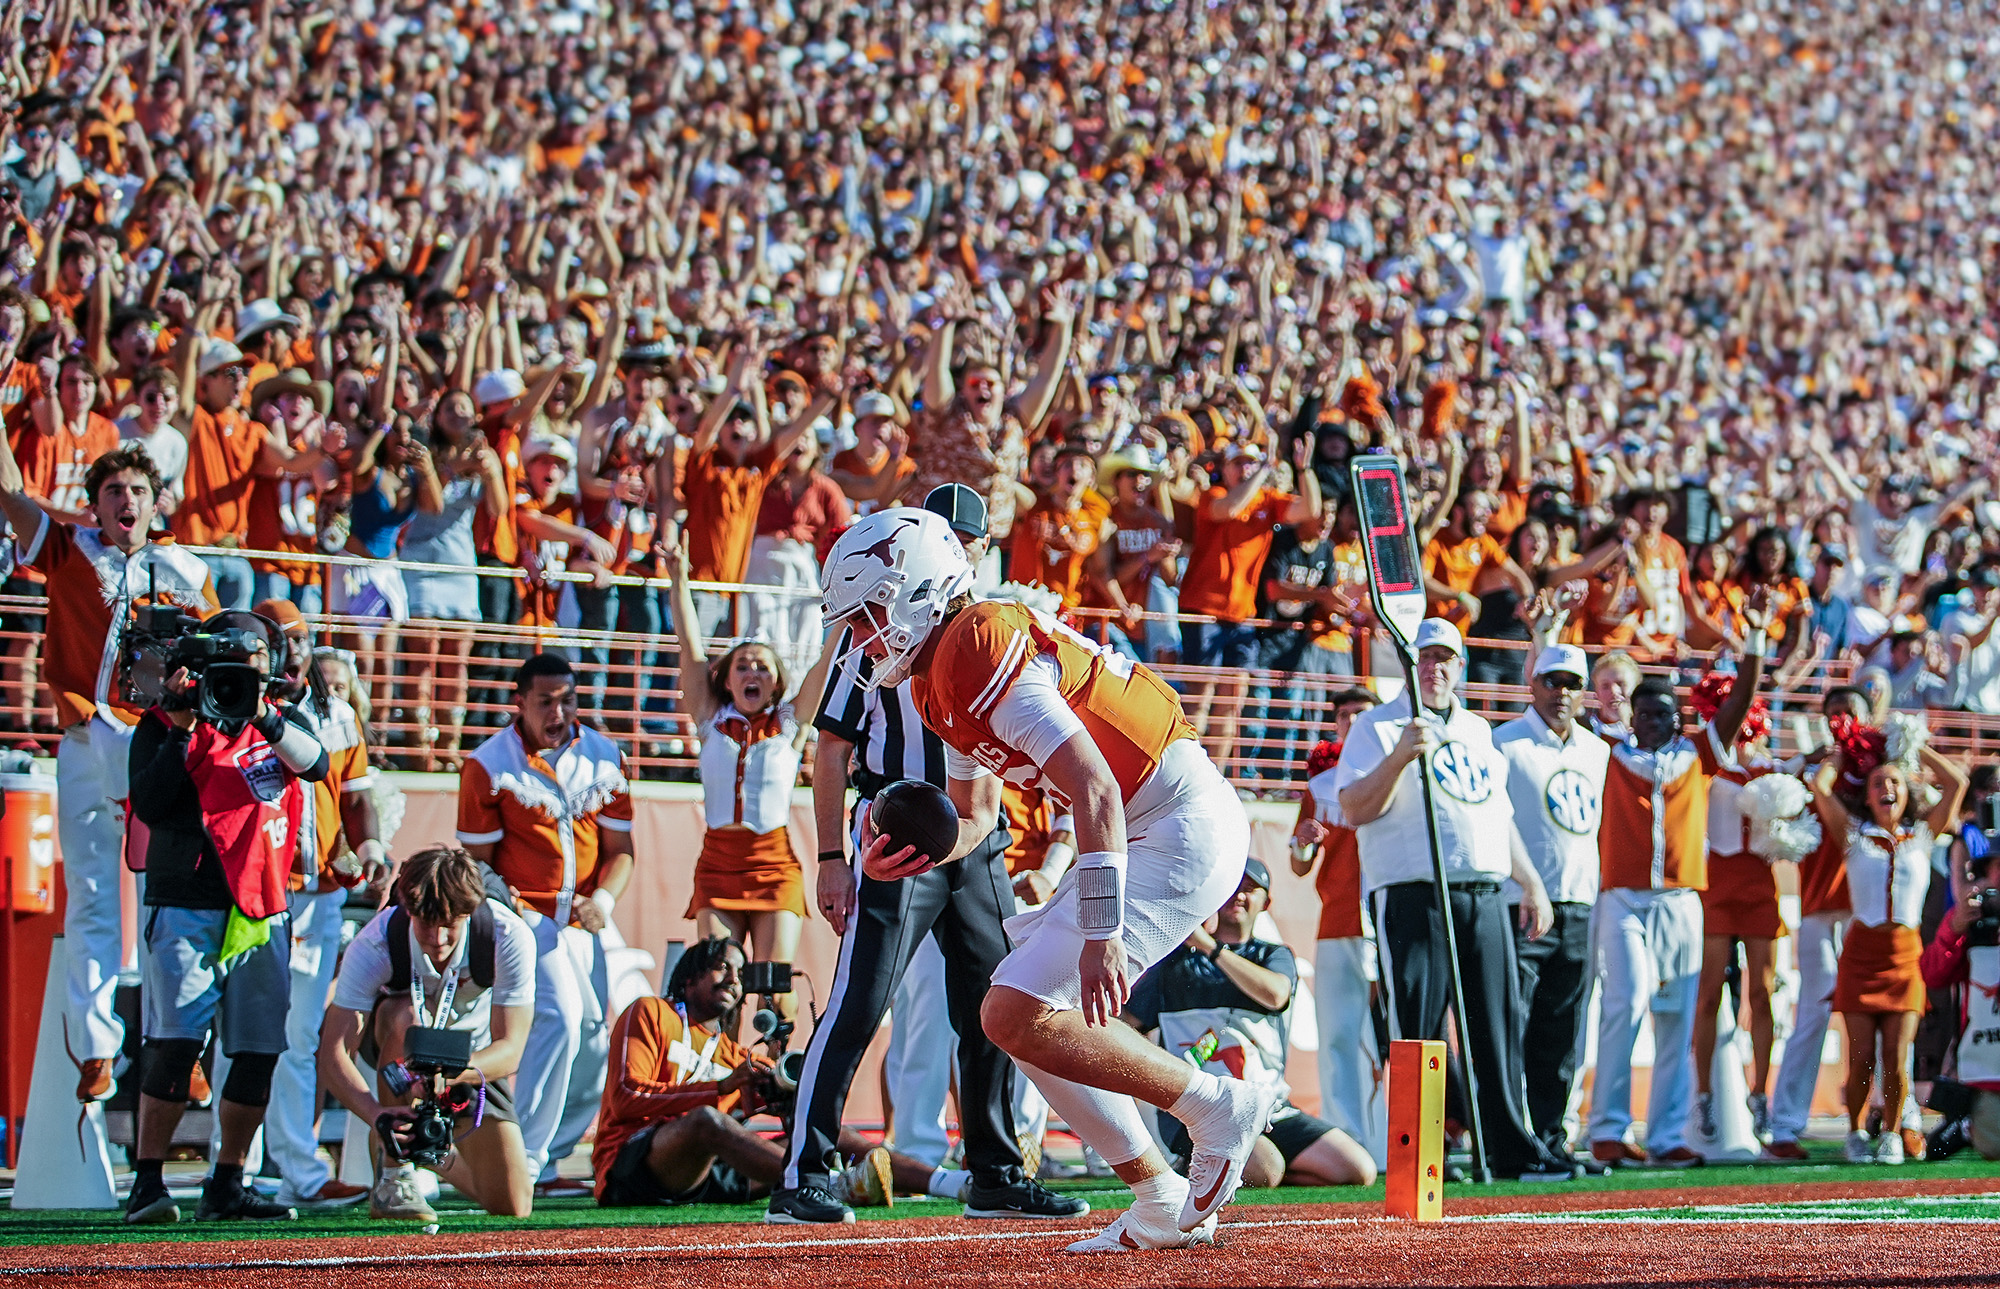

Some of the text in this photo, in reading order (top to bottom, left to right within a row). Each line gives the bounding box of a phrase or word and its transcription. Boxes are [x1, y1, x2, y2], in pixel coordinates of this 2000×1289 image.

[1359, 469, 1414, 592] 2
[246, 763, 282, 781] COLLE
[972, 742, 1008, 773] AS
[1433, 742, 1490, 802] SEC
[1547, 770, 1596, 833] SEC
